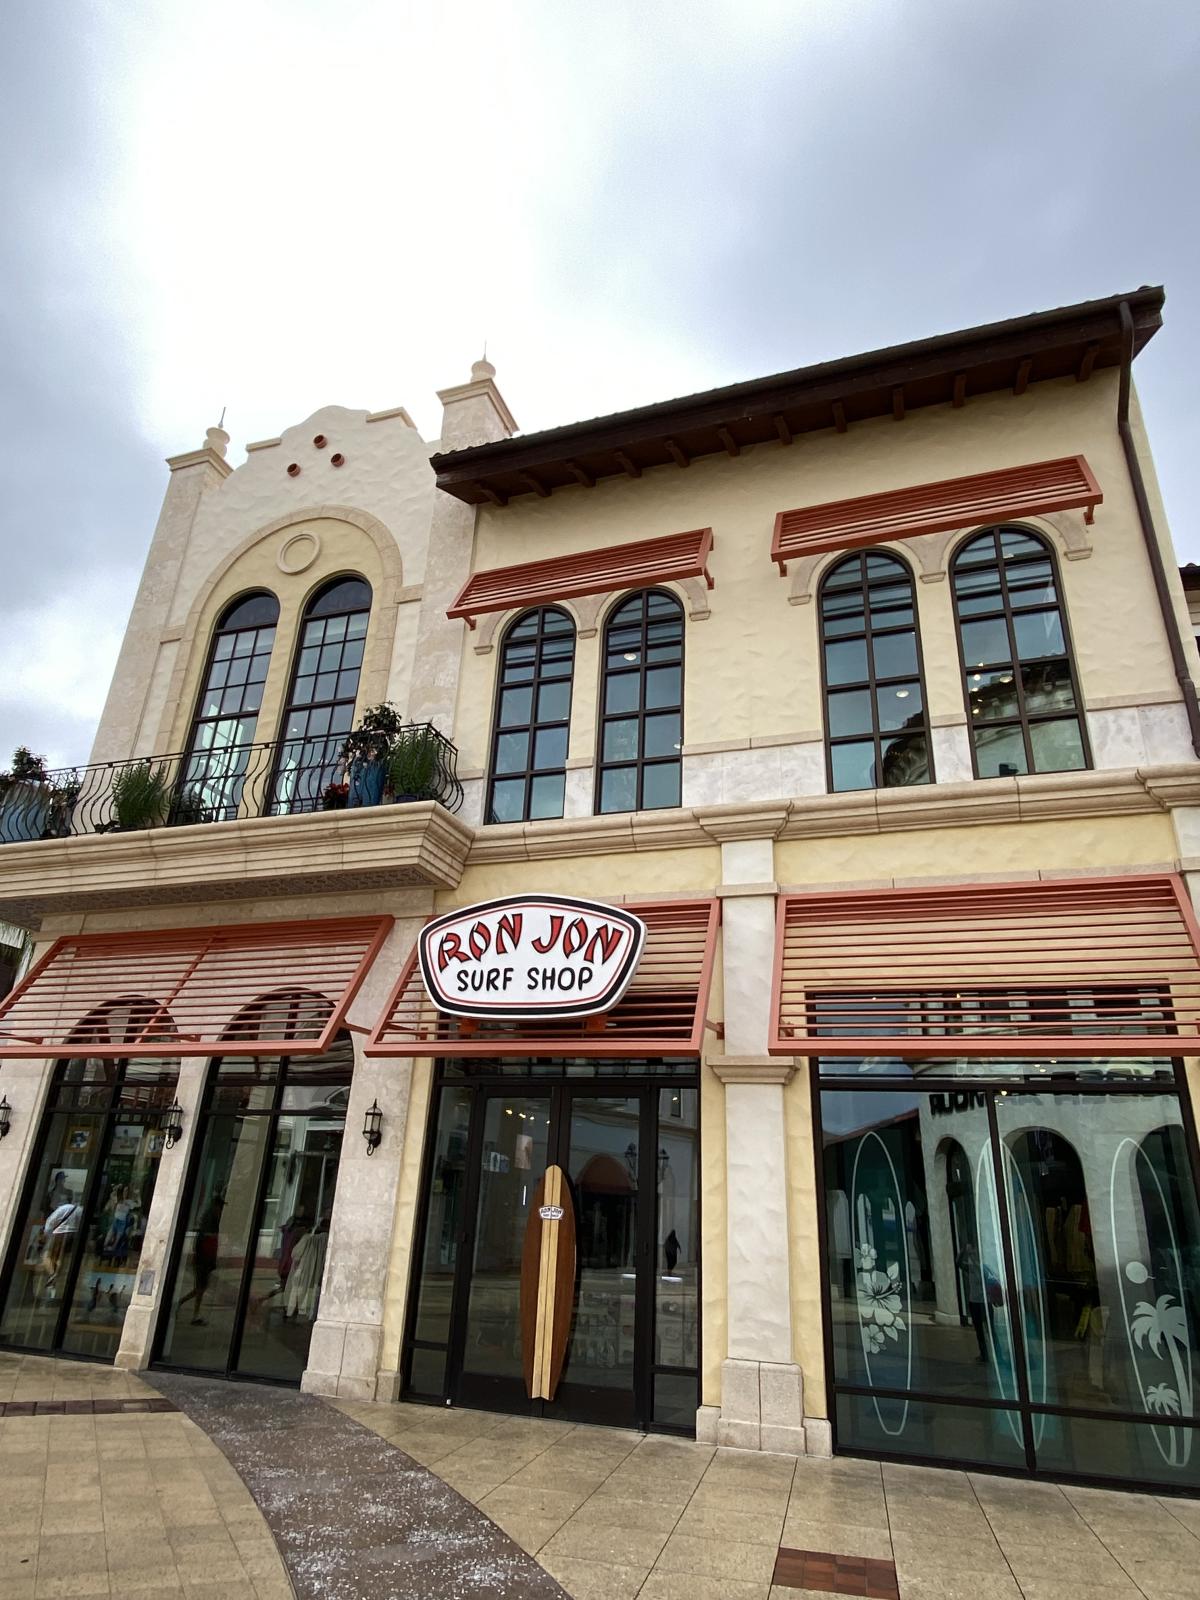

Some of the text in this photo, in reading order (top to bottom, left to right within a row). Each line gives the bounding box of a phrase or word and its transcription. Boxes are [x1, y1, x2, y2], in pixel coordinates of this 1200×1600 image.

[437, 913, 624, 973] RON JON
[456, 966, 593, 992] SURF SHOP
